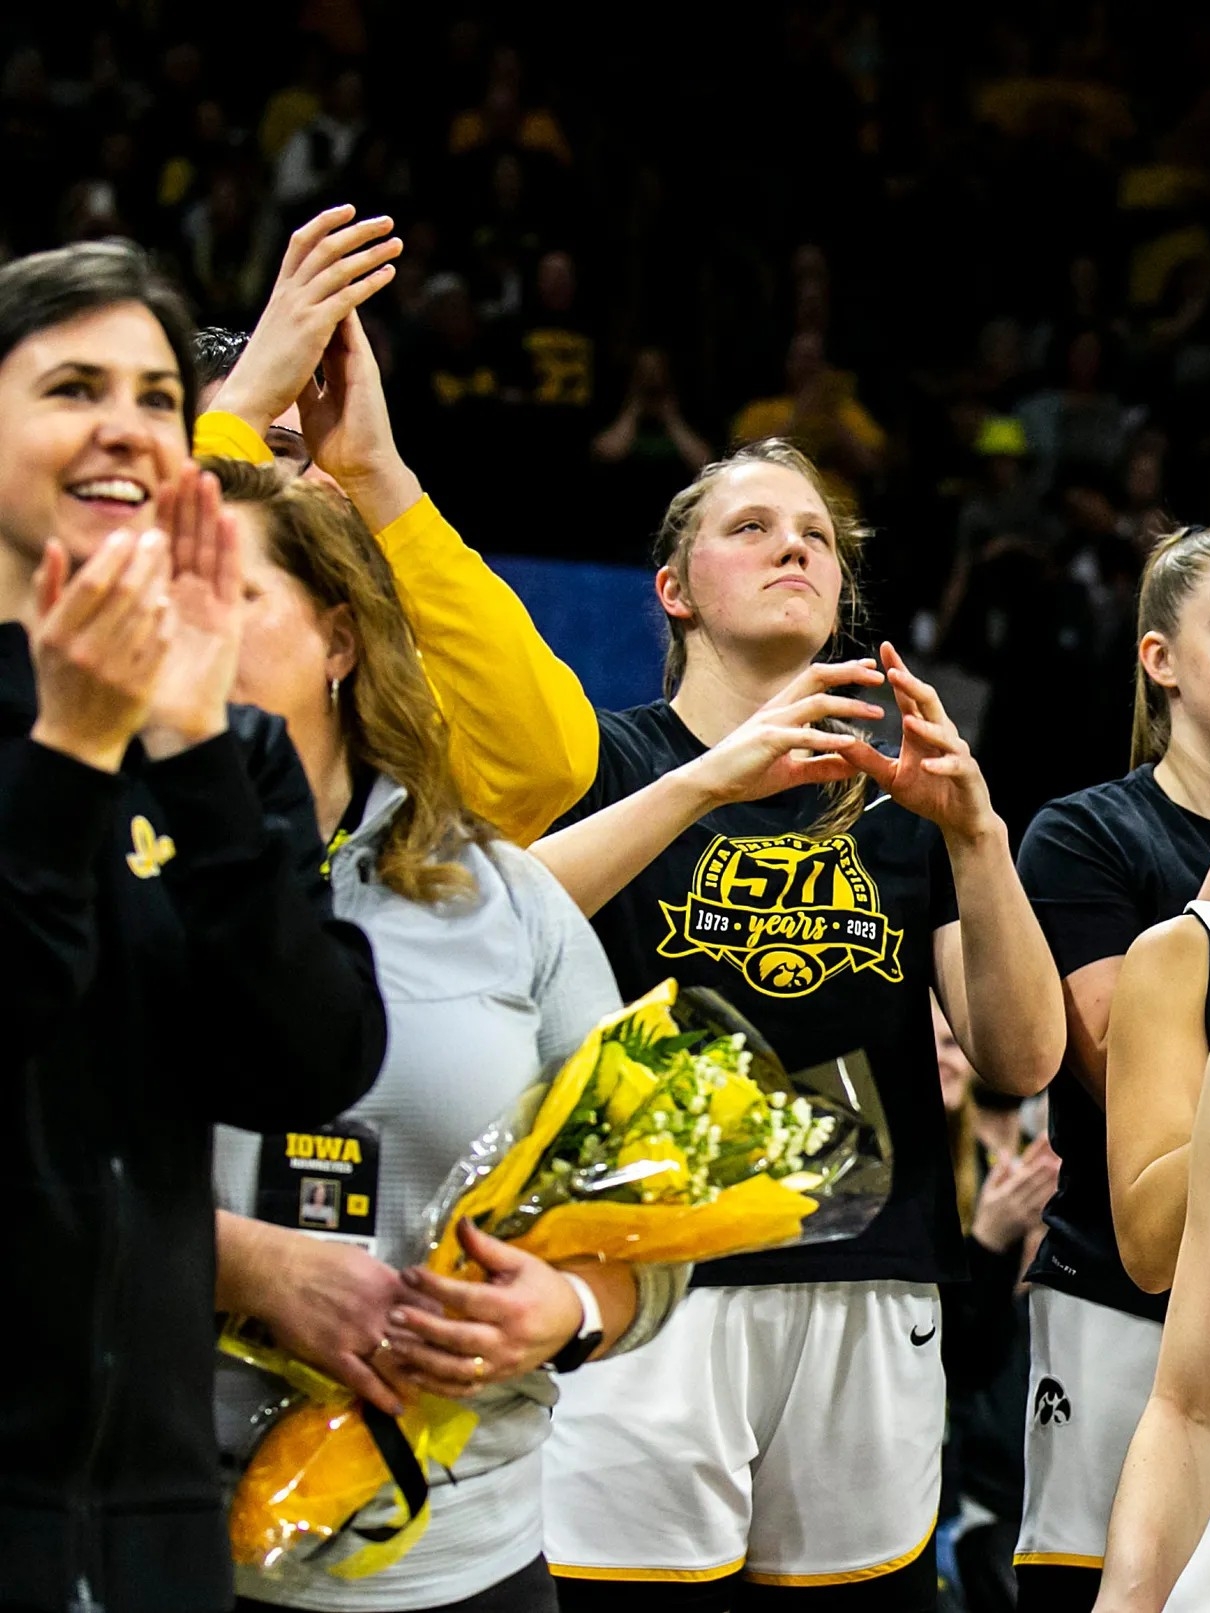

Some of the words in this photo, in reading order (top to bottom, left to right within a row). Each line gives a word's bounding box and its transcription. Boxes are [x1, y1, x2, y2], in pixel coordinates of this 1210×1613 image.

[704, 849, 731, 888] IOWA
[696, 909, 729, 932] 1973
[747, 911, 828, 948] years
[847, 919, 877, 941] 2023
[285, 1132, 362, 1164] IOWA
